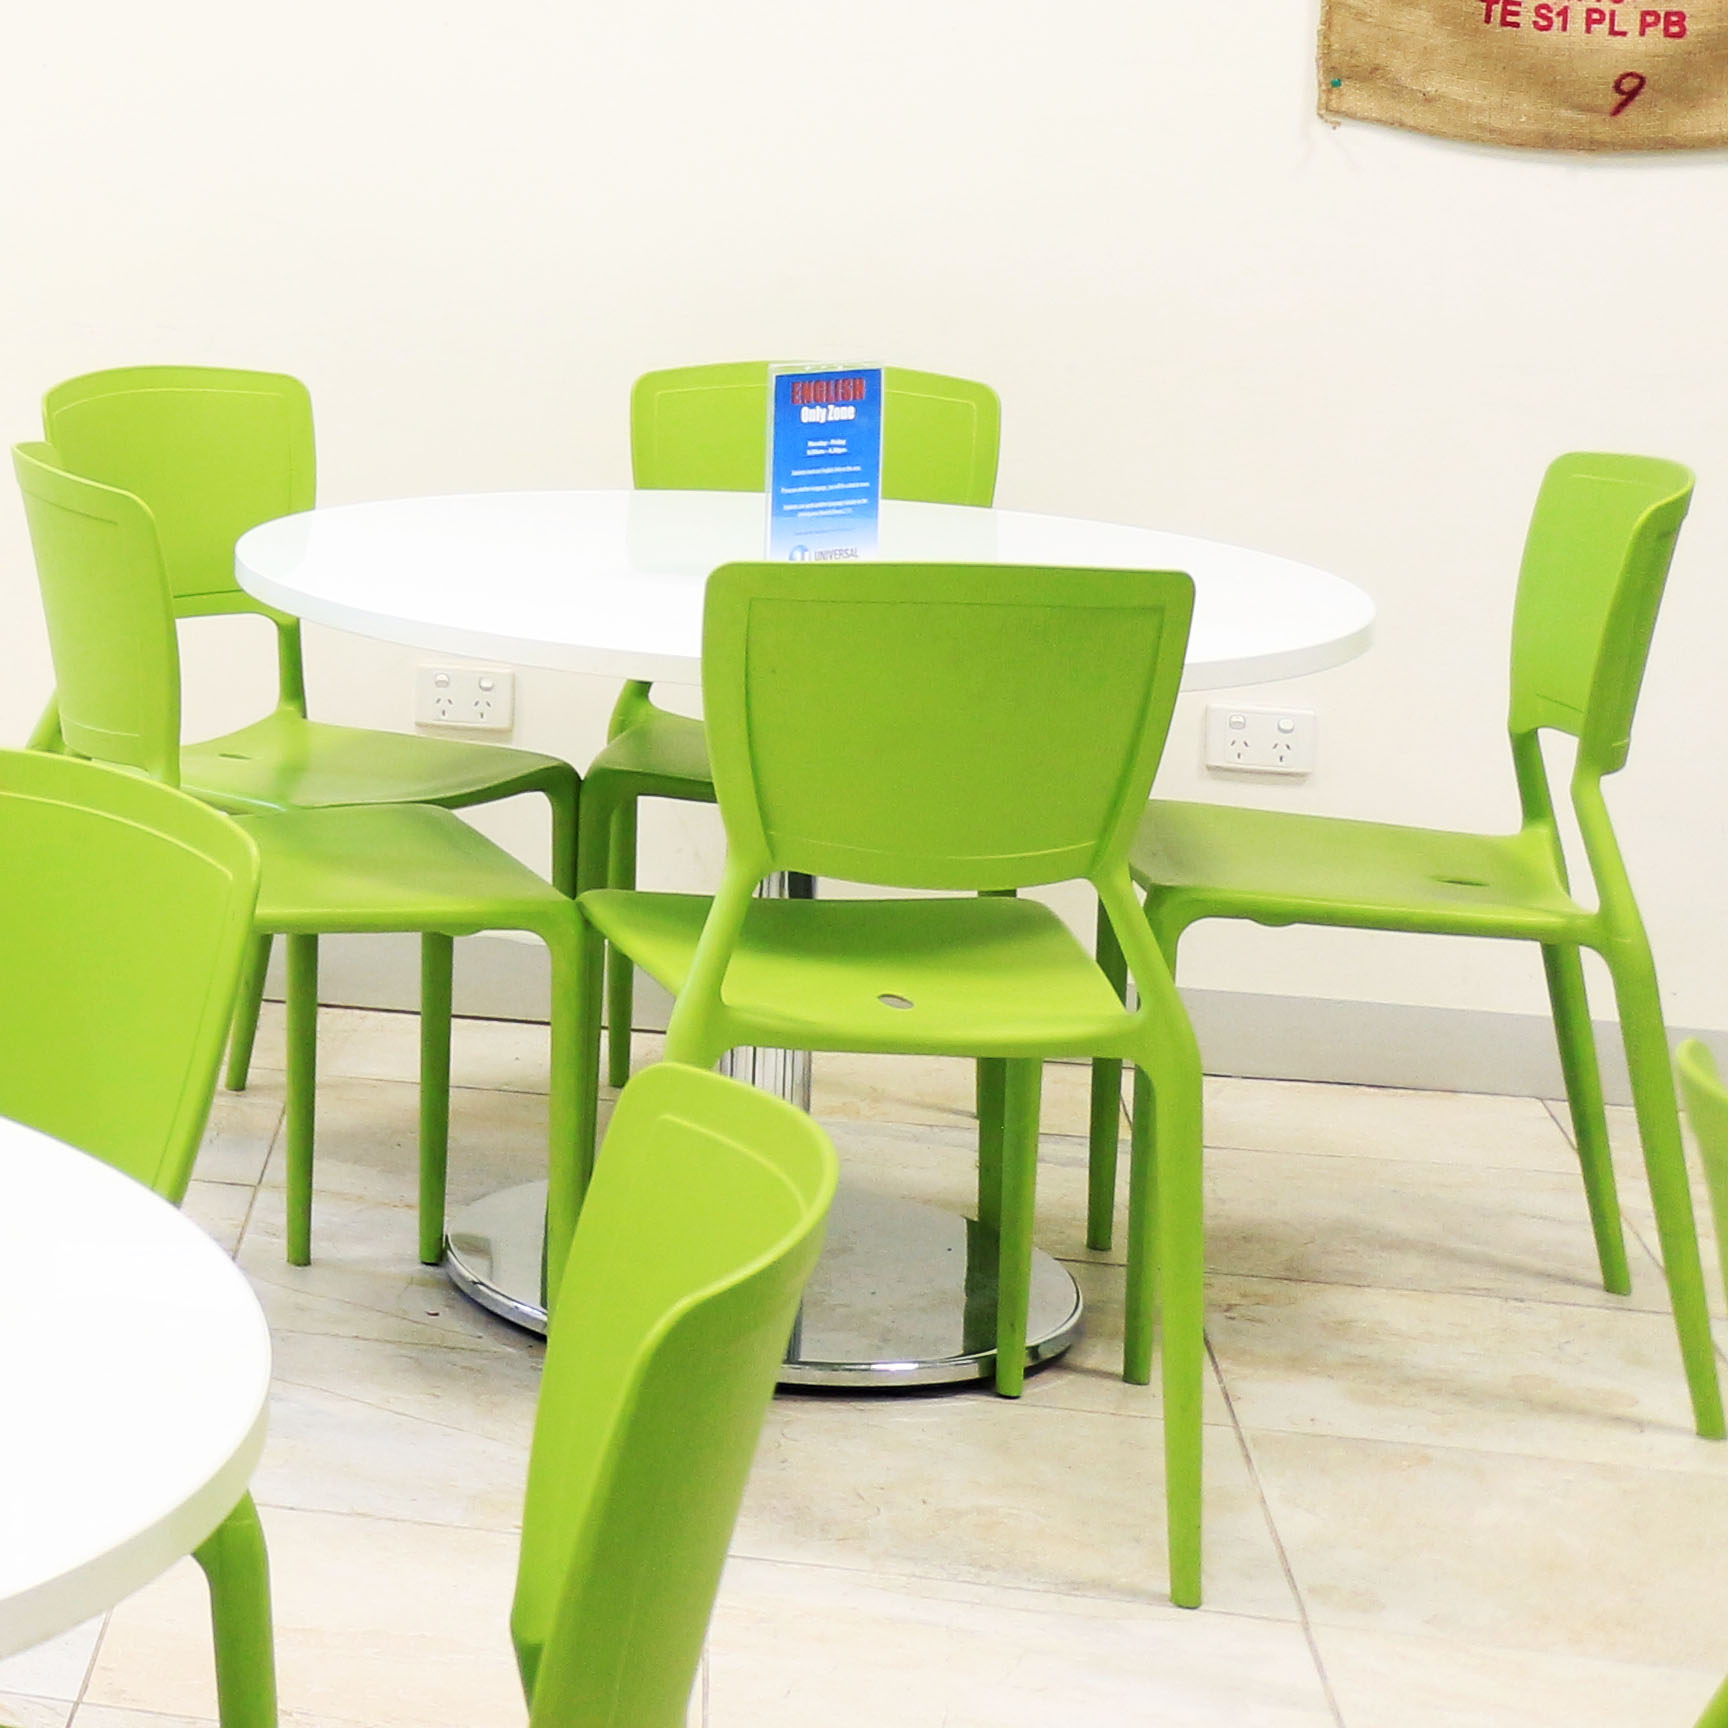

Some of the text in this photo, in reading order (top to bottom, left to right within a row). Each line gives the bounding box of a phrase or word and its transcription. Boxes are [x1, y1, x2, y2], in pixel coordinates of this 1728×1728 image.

[1532, 2, 1571, 32] S1
[1584, 7, 1629, 38] PL
[1638, 9, 1688, 40] PB
[1610, 71, 1647, 117] 9
[791, 377, 866, 404] ENGLISH
[800, 404, 856, 424] Only Zone
